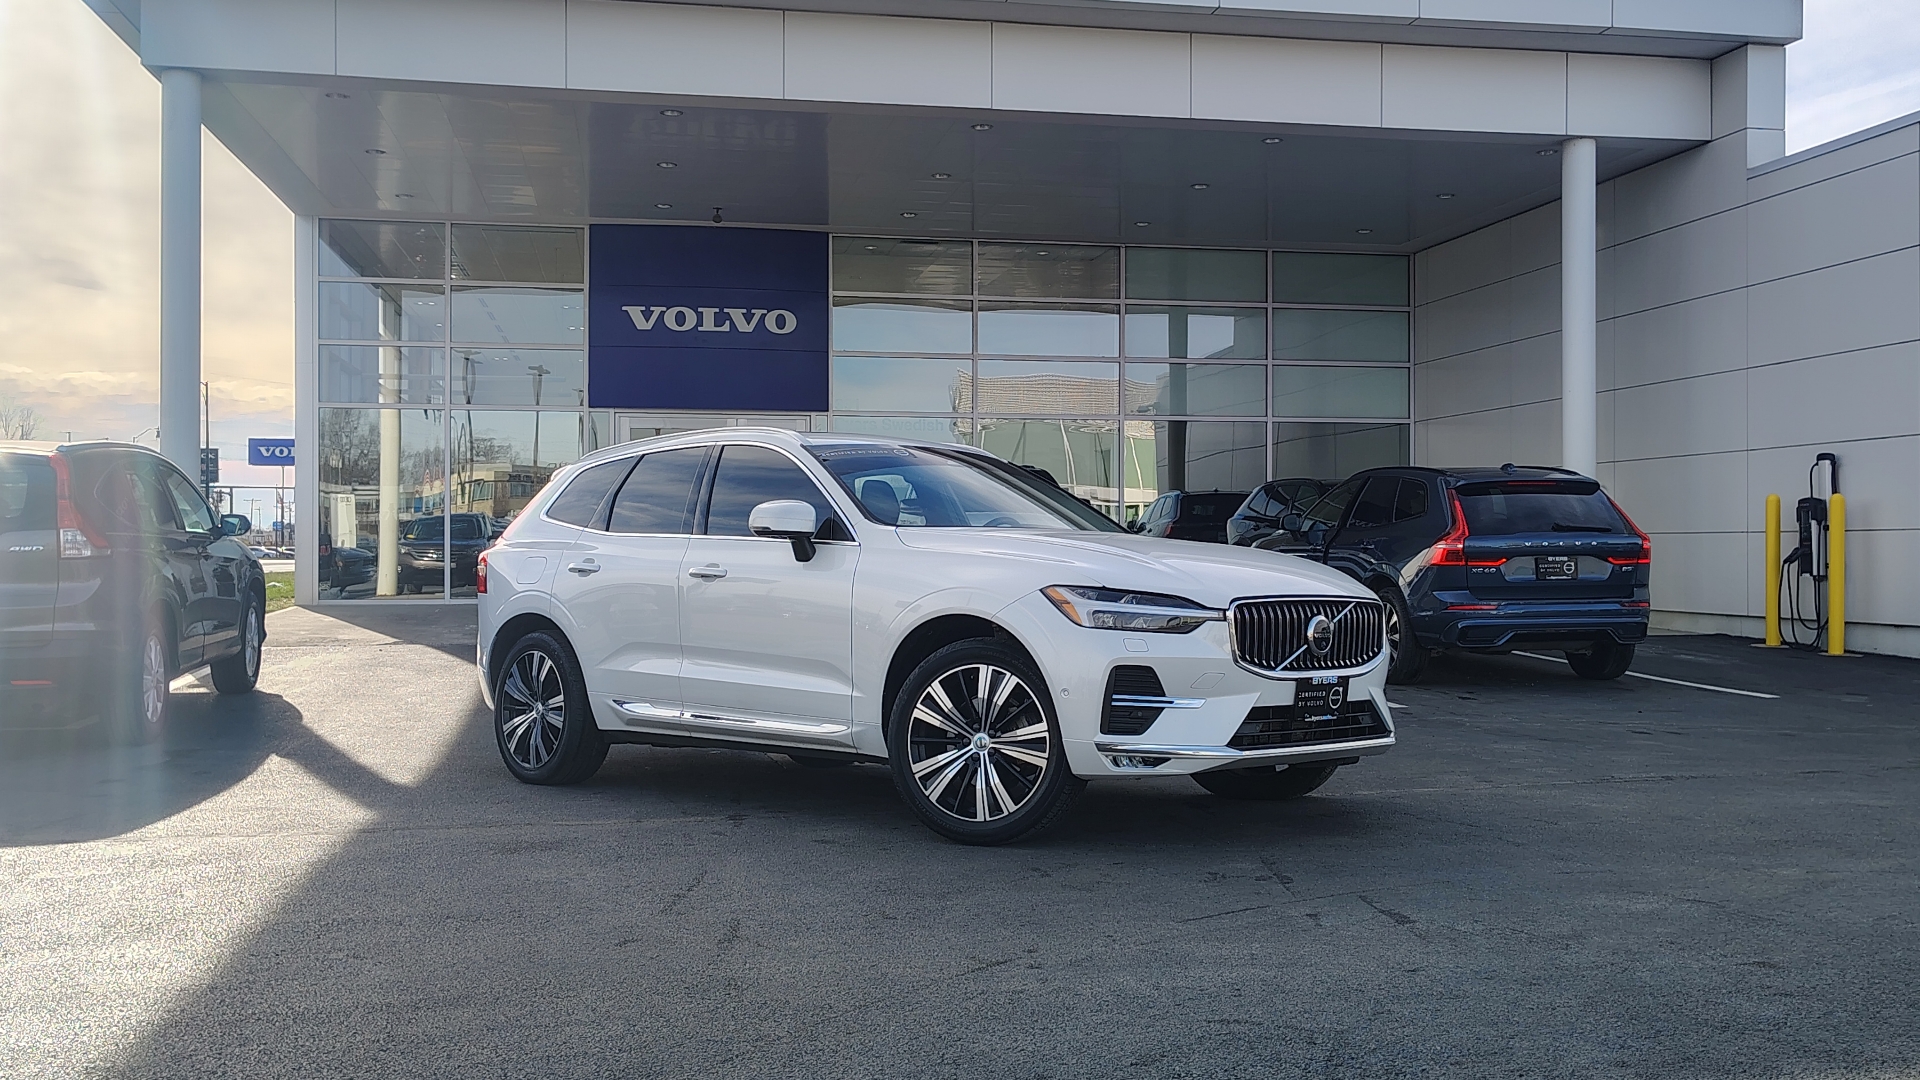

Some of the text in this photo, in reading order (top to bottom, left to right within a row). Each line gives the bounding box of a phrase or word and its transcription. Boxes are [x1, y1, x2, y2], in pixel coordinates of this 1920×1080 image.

[621, 305, 797, 335] VOLVO
[882, 418, 944, 432] Swedish
[1312, 676, 1338, 685] BYERS
